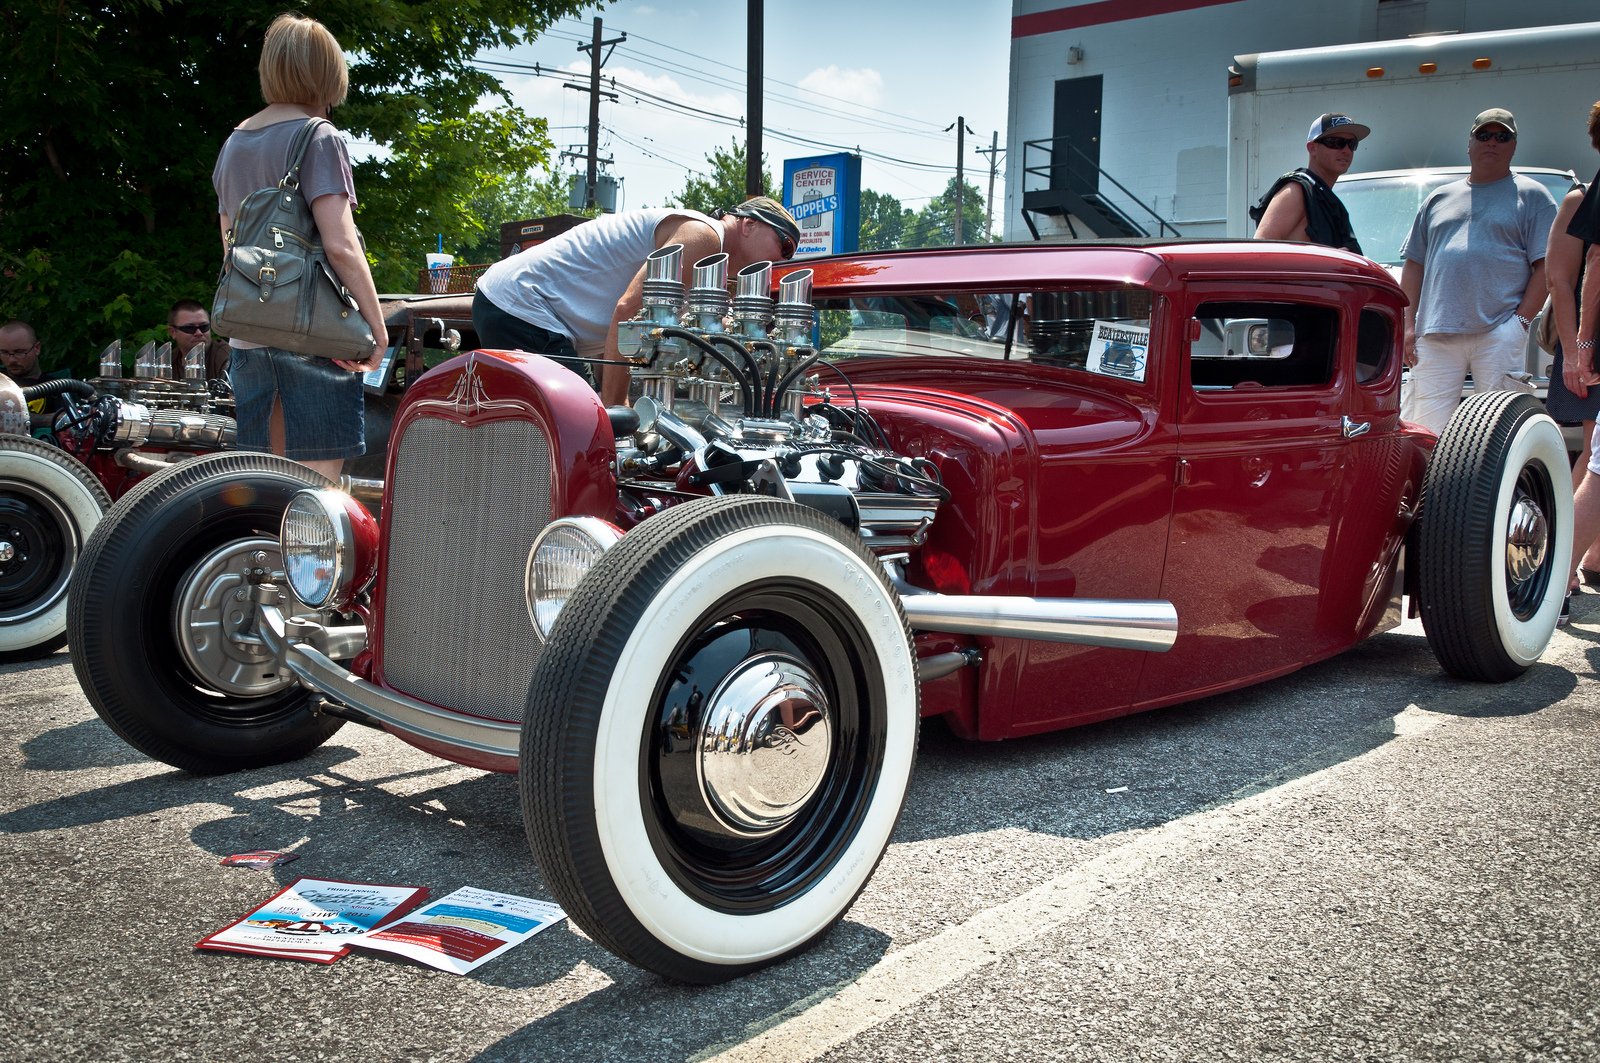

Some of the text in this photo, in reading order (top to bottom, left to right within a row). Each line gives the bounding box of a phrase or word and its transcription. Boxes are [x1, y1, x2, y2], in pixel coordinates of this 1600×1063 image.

[795, 169, 834, 181] SERVICE
[795, 178, 832, 188] CENTER
[1098, 325, 1149, 347] BEATERSVILLE
